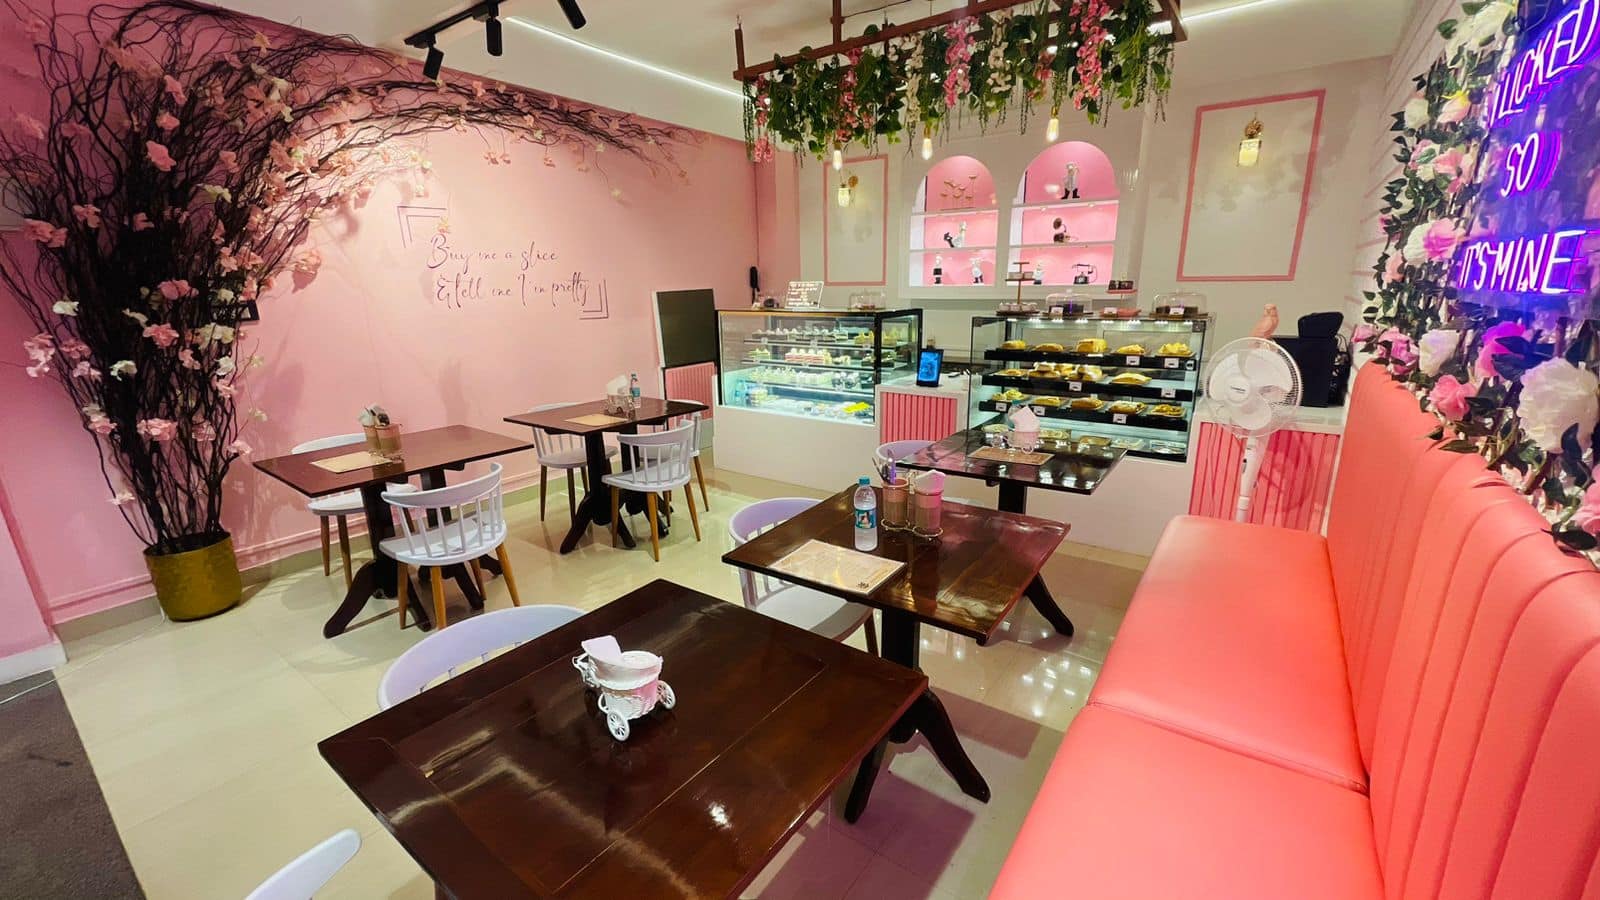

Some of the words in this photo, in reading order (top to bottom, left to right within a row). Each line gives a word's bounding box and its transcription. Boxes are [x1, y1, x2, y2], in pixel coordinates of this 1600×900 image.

[1498, 0, 1600, 119] LICKED
[1501, 132, 1540, 198] SO
[427, 233, 469, 275] Buy
[478, 251, 497, 260] me
[504, 251, 513, 260] a
[521, 241, 559, 271] slice
[1490, 229, 1587, 294] MINE
[491, 288, 512, 297] me
[550, 272, 589, 307] pretty
